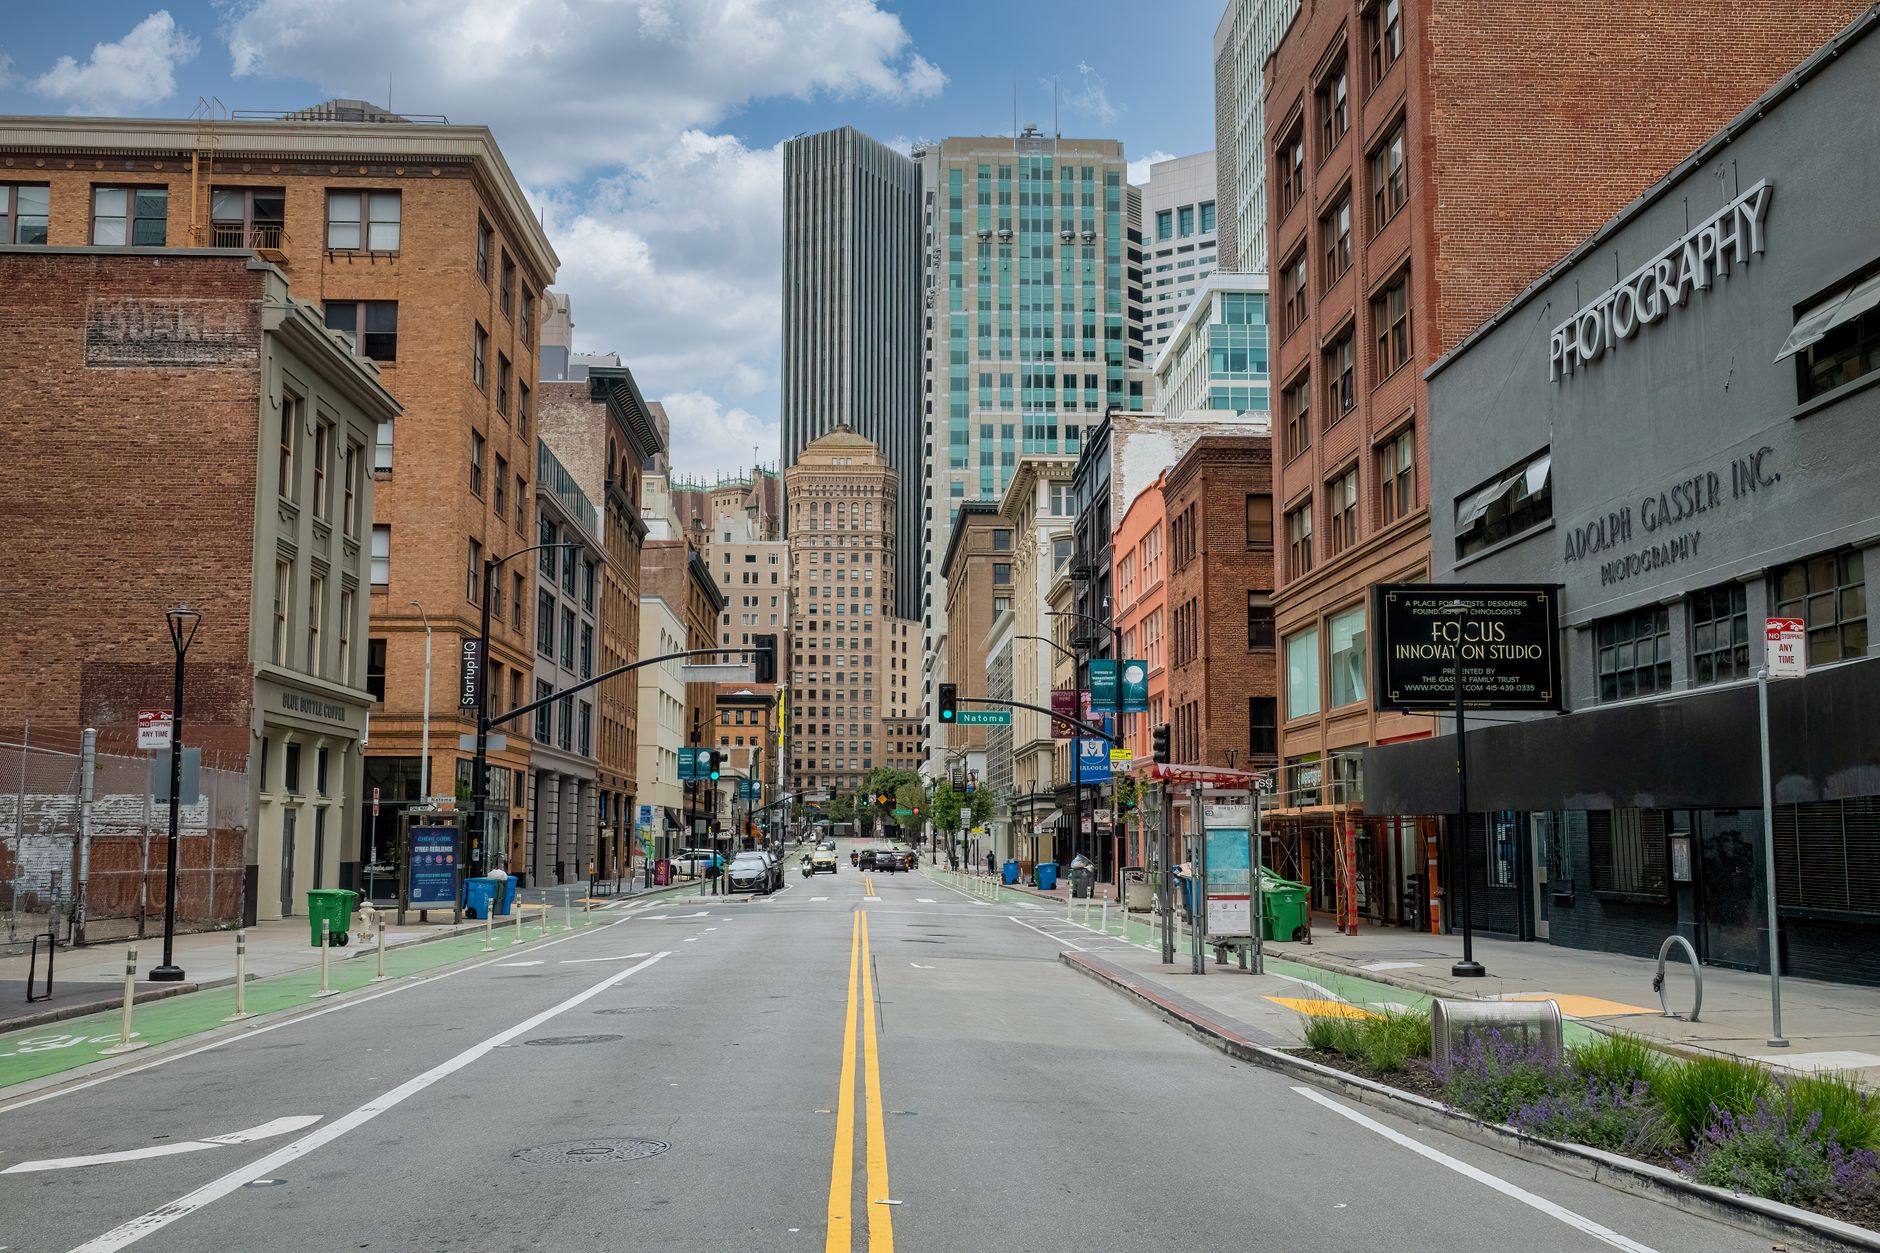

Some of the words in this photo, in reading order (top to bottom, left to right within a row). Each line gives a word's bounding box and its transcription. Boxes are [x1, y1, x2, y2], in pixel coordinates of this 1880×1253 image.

[1549, 182, 1773, 383] PHOTOGRAPHY
[1564, 506, 1632, 564] ADOLPH
[1641, 471, 1721, 533] GASSER
[1730, 446, 1781, 500] INC.
[1600, 529, 1701, 587] PHOTOGRAPHY
[1431, 621, 1505, 642] FOCUS
[1768, 632, 1780, 640] NO
[1396, 644, 1484, 659] INNOVATON
[1489, 644, 1542, 659] STUDIO
[1779, 644, 1793, 652] ANY
[1778, 656, 1795, 664] TIME
[462, 641, 478, 705] StartupHQ
[282, 692, 299, 711] BLUE
[299, 697, 323, 717] BOTTLE
[323, 703, 346, 722] COFFEE
[963, 714, 1004, 722] Natoma
